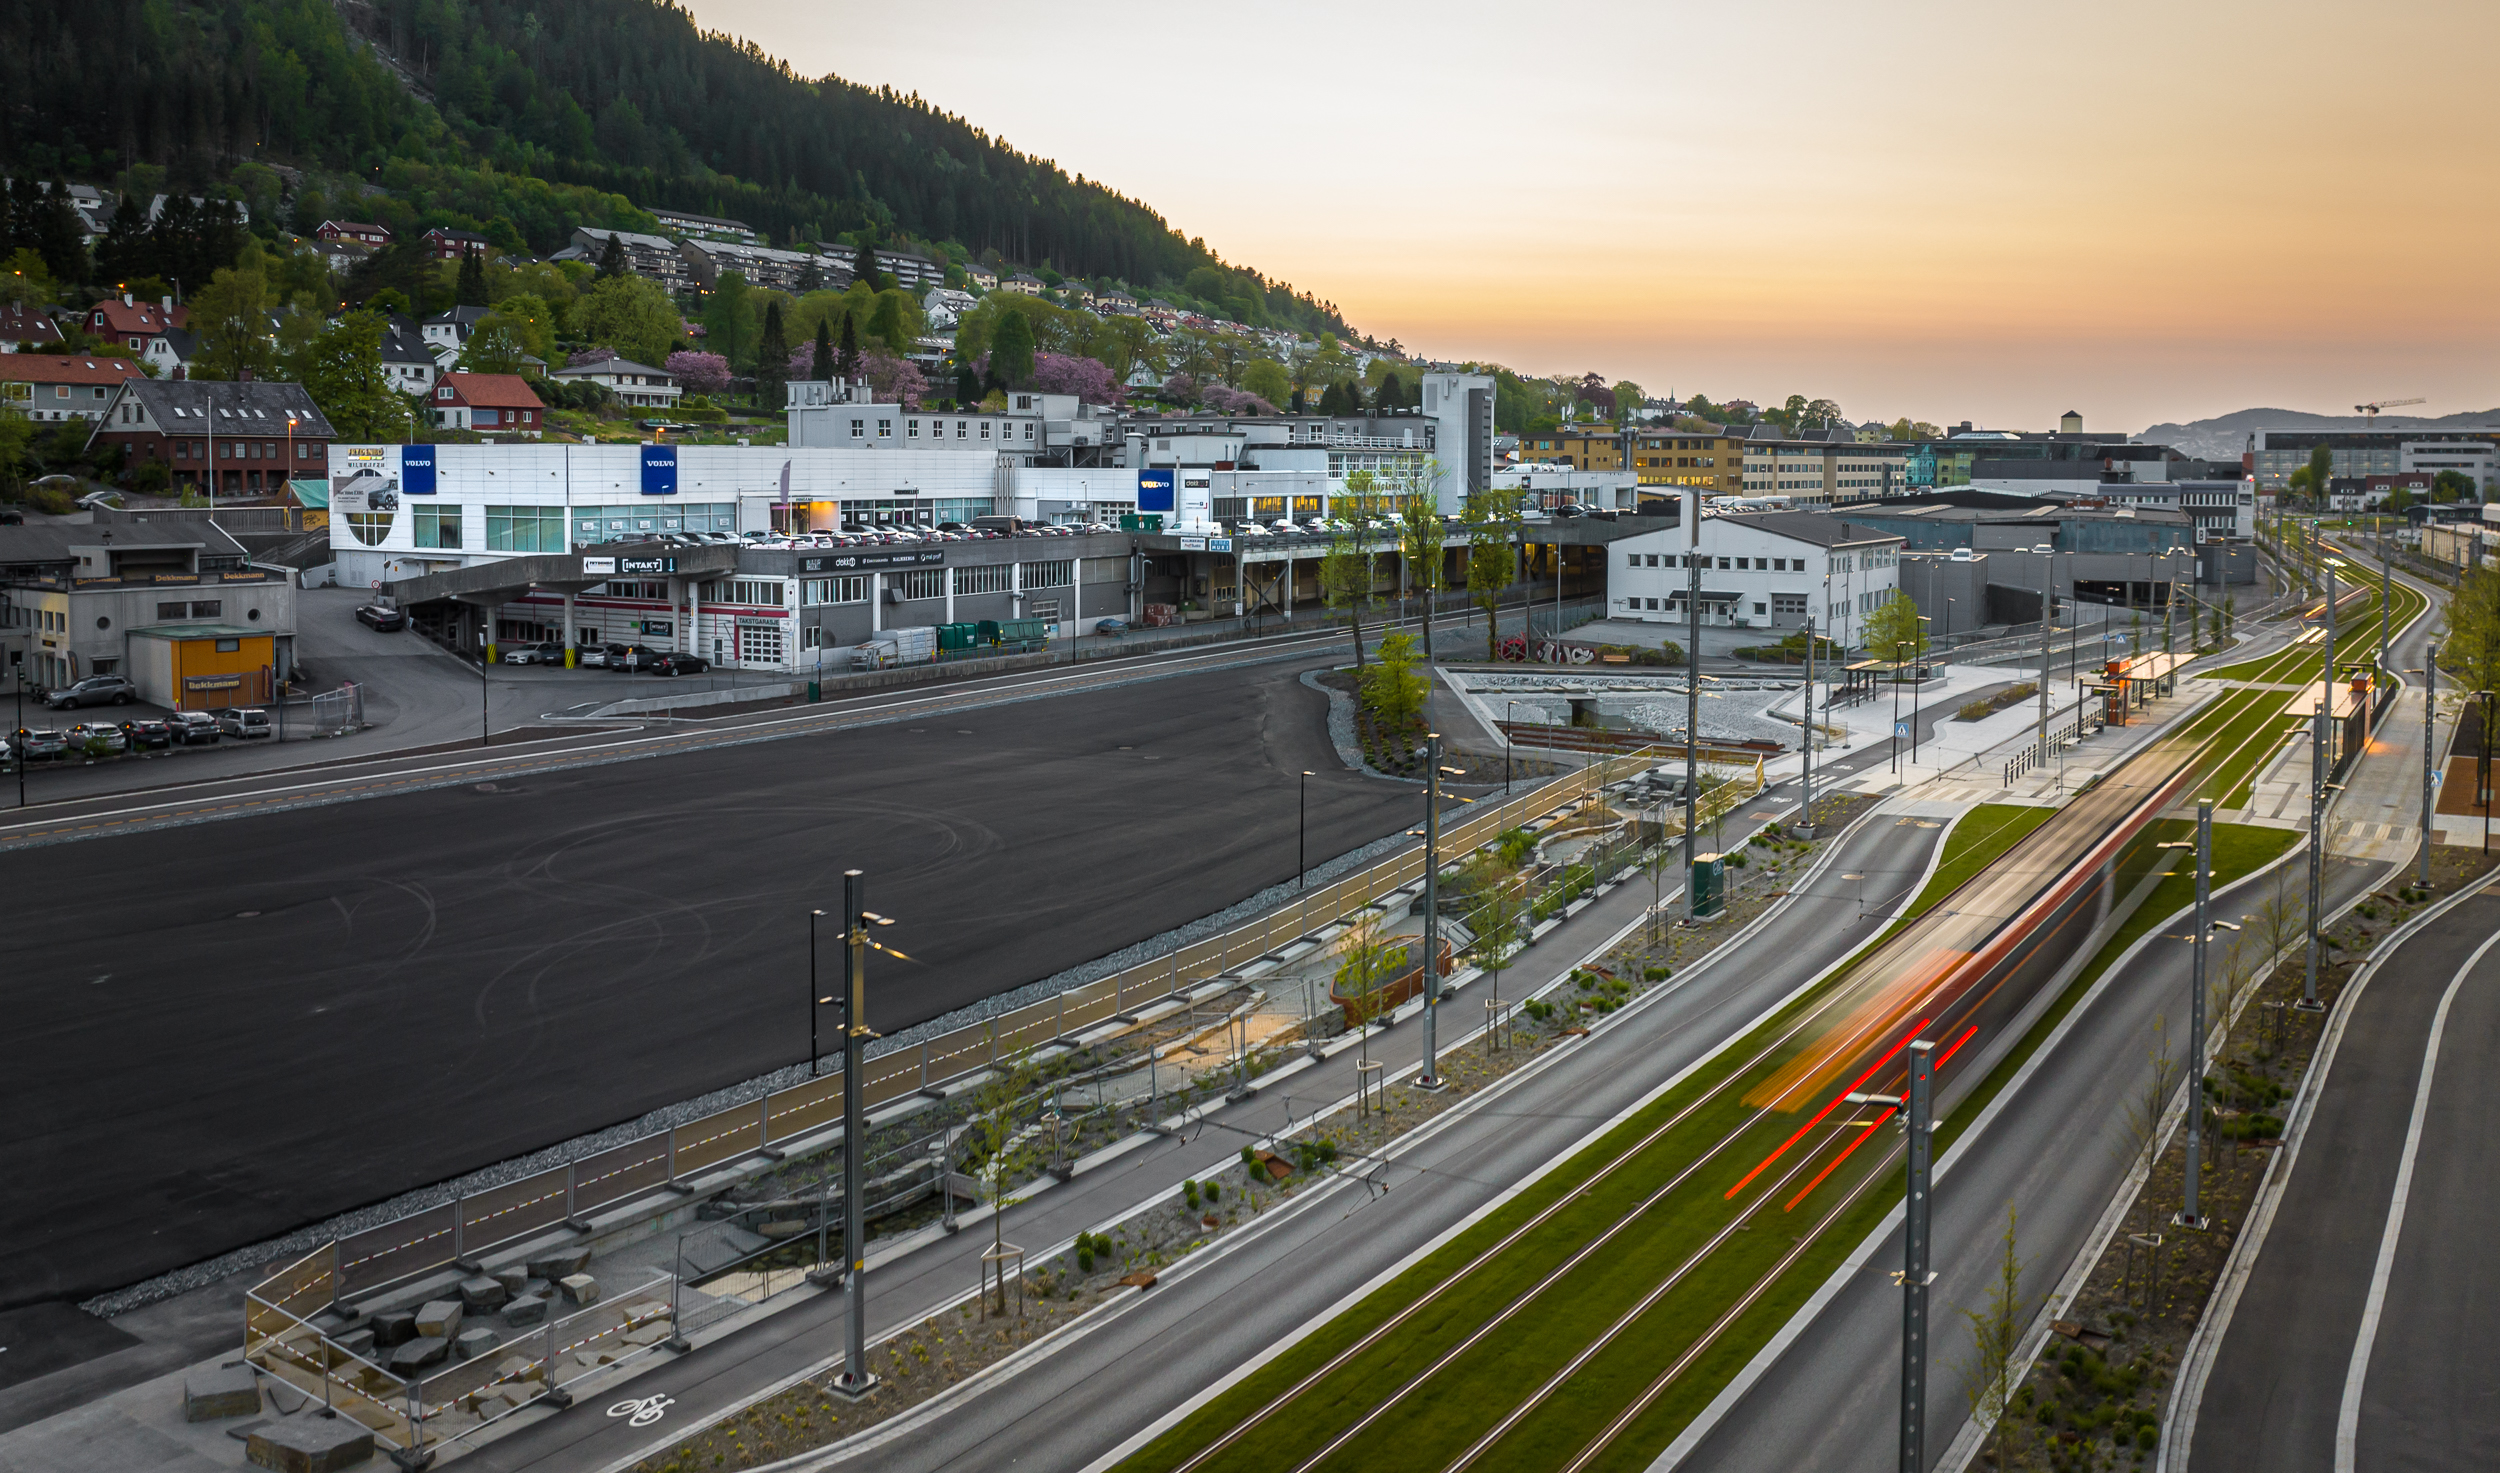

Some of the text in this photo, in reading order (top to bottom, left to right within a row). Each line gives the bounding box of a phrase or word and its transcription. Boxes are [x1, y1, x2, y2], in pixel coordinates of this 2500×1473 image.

[626, 561, 659, 569] INTAKT
[155, 574, 198, 582] Dekkmann
[739, 617, 779, 626] TAKSTGARASJE
